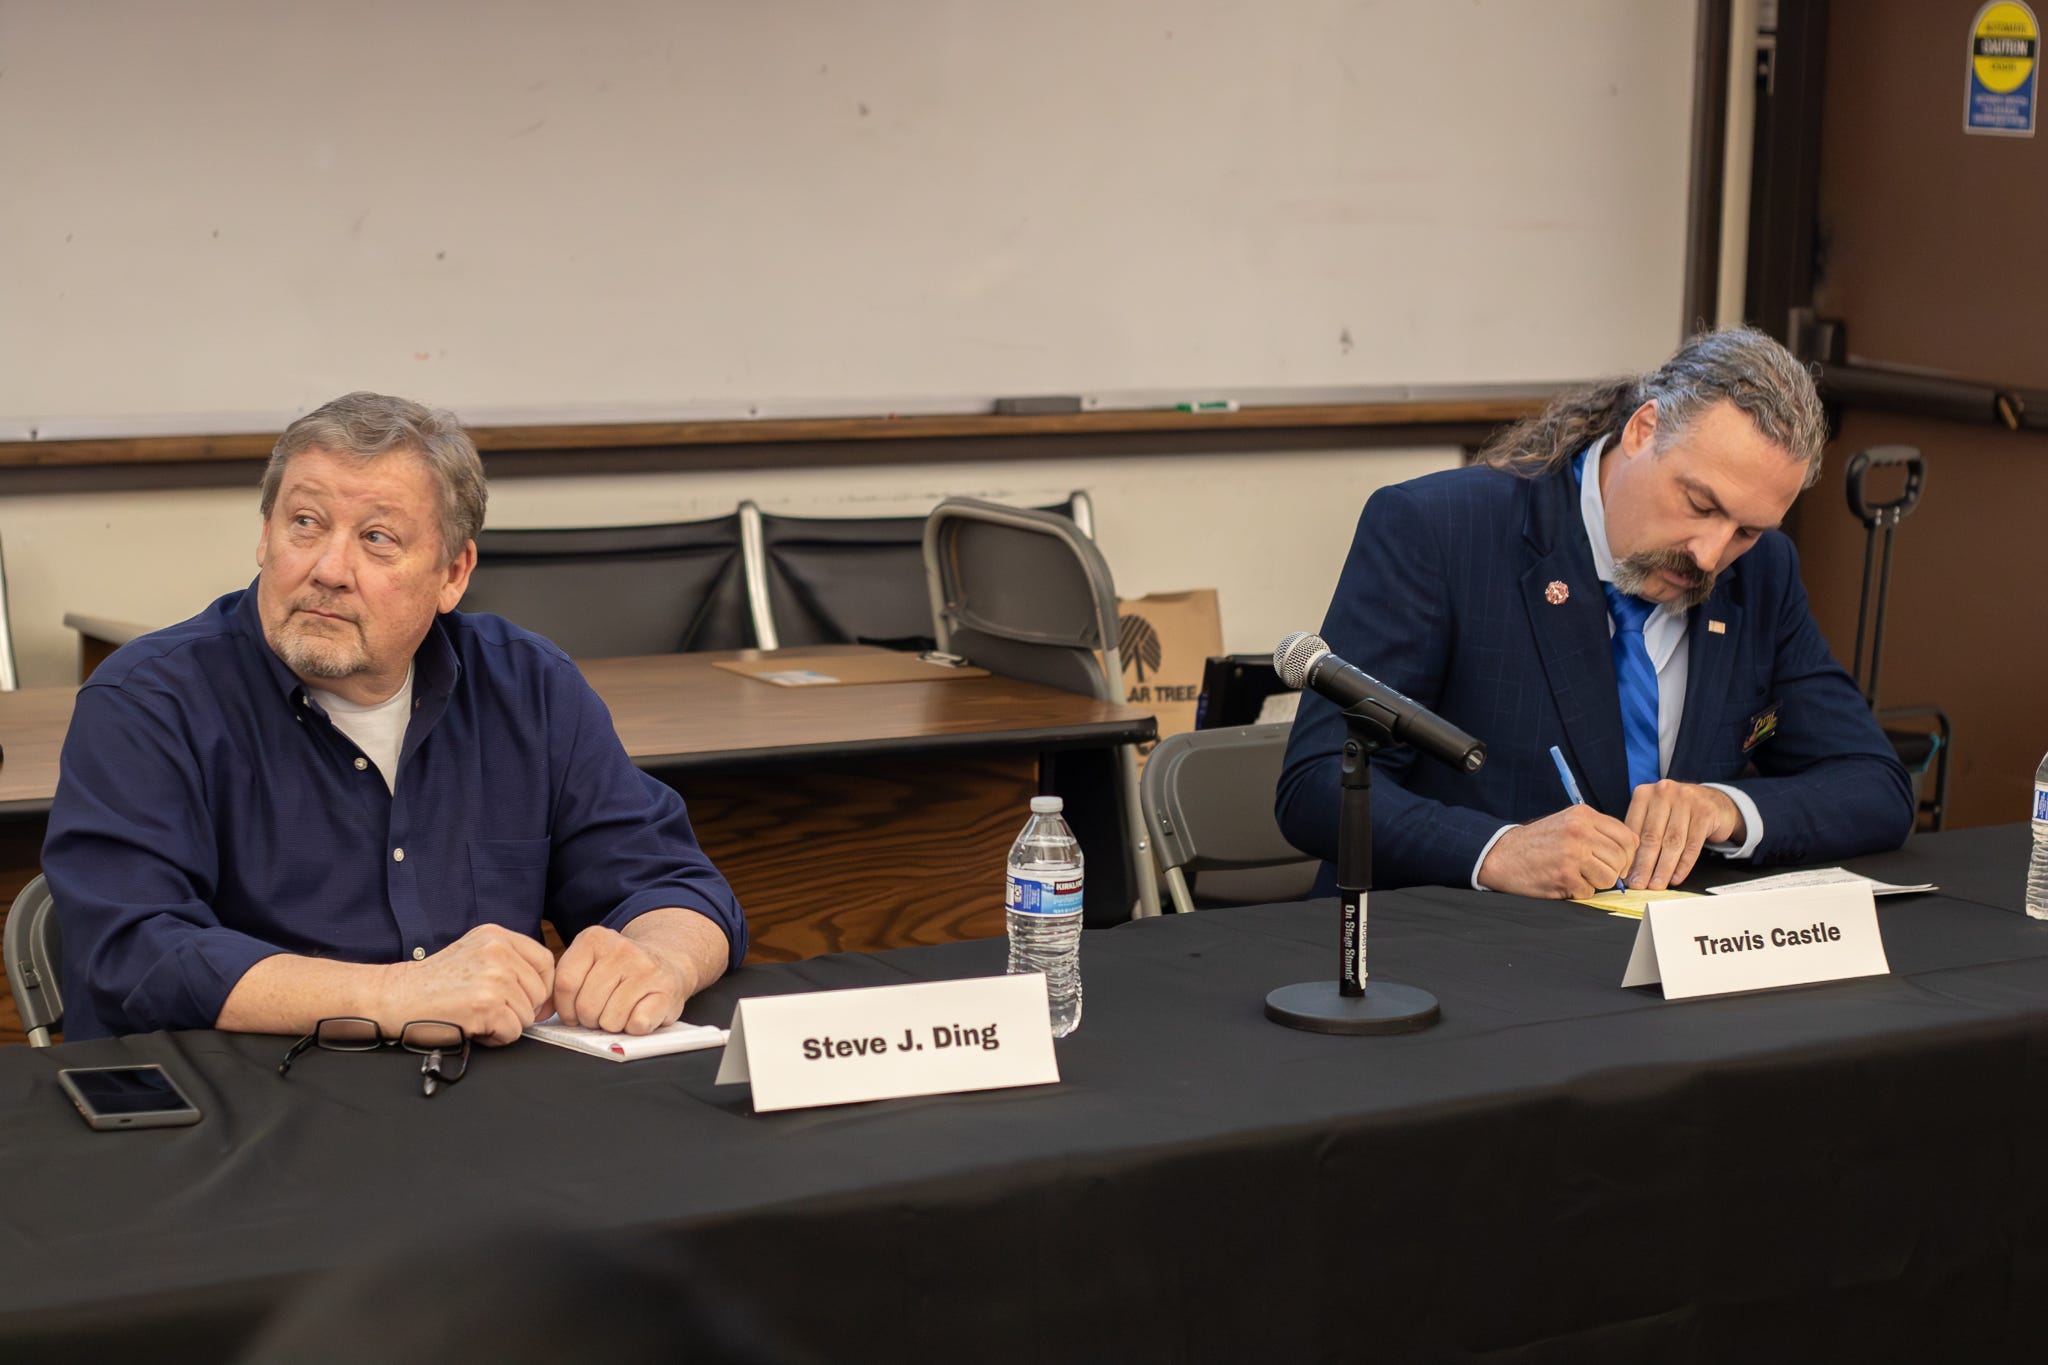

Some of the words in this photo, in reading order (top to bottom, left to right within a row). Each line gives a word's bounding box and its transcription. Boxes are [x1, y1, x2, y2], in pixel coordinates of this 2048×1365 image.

[1982, 38, 2028, 56] CAUTION
[1155, 685, 1197, 702] TREE
[1344, 904, 1356, 919] On
[1343, 921, 1356, 948] Stage
[1693, 930, 1765, 956] Travis
[1770, 922, 1841, 948] Castle
[1344, 948, 1356, 980] Stands
[802, 1036, 888, 1061] Steve
[897, 1029, 923, 1053] J.
[932, 1023, 1000, 1051] Ding
